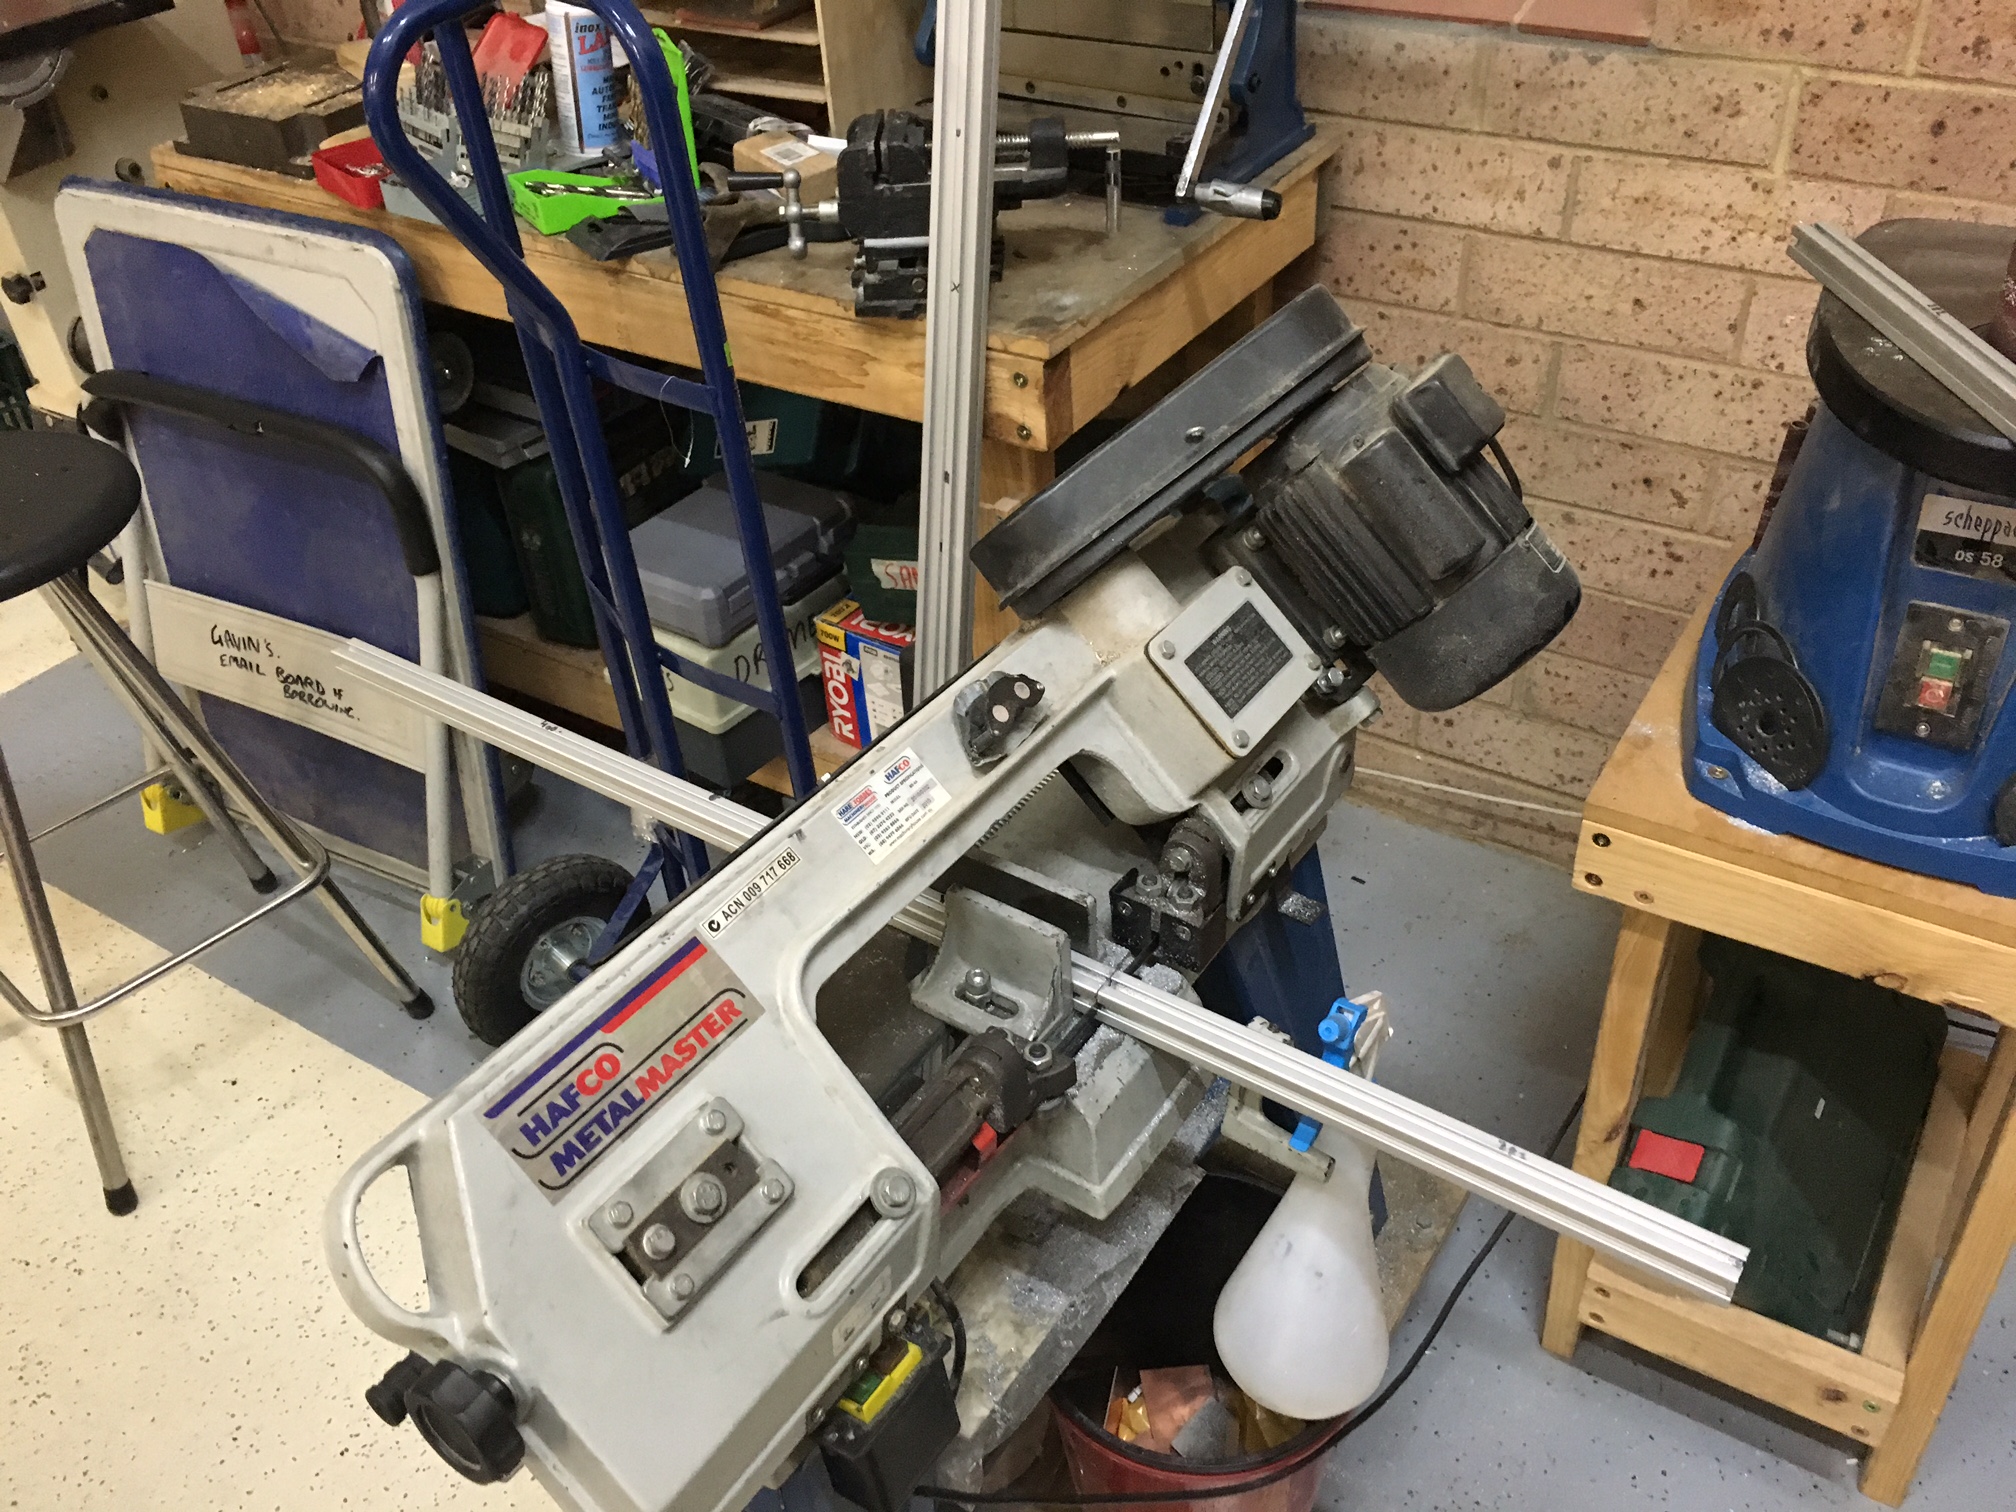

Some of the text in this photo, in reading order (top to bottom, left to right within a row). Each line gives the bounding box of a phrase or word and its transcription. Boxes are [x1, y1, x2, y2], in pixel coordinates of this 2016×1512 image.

[1980, 551, 2003, 568] 58
[820, 630, 839, 642] 700W
[220, 654, 266, 676] EMAIL
[275, 666, 325, 695] BOARD
[823, 651, 855, 739] RYOBI
[885, 759, 910, 781] HAFCO
[885, 783, 901, 798] PRODUCT
[722, 851, 796, 921] ACN 009 717 668
[519, 1053, 621, 1146] HAFCO
[550, 999, 742, 1177] METALMASTER
